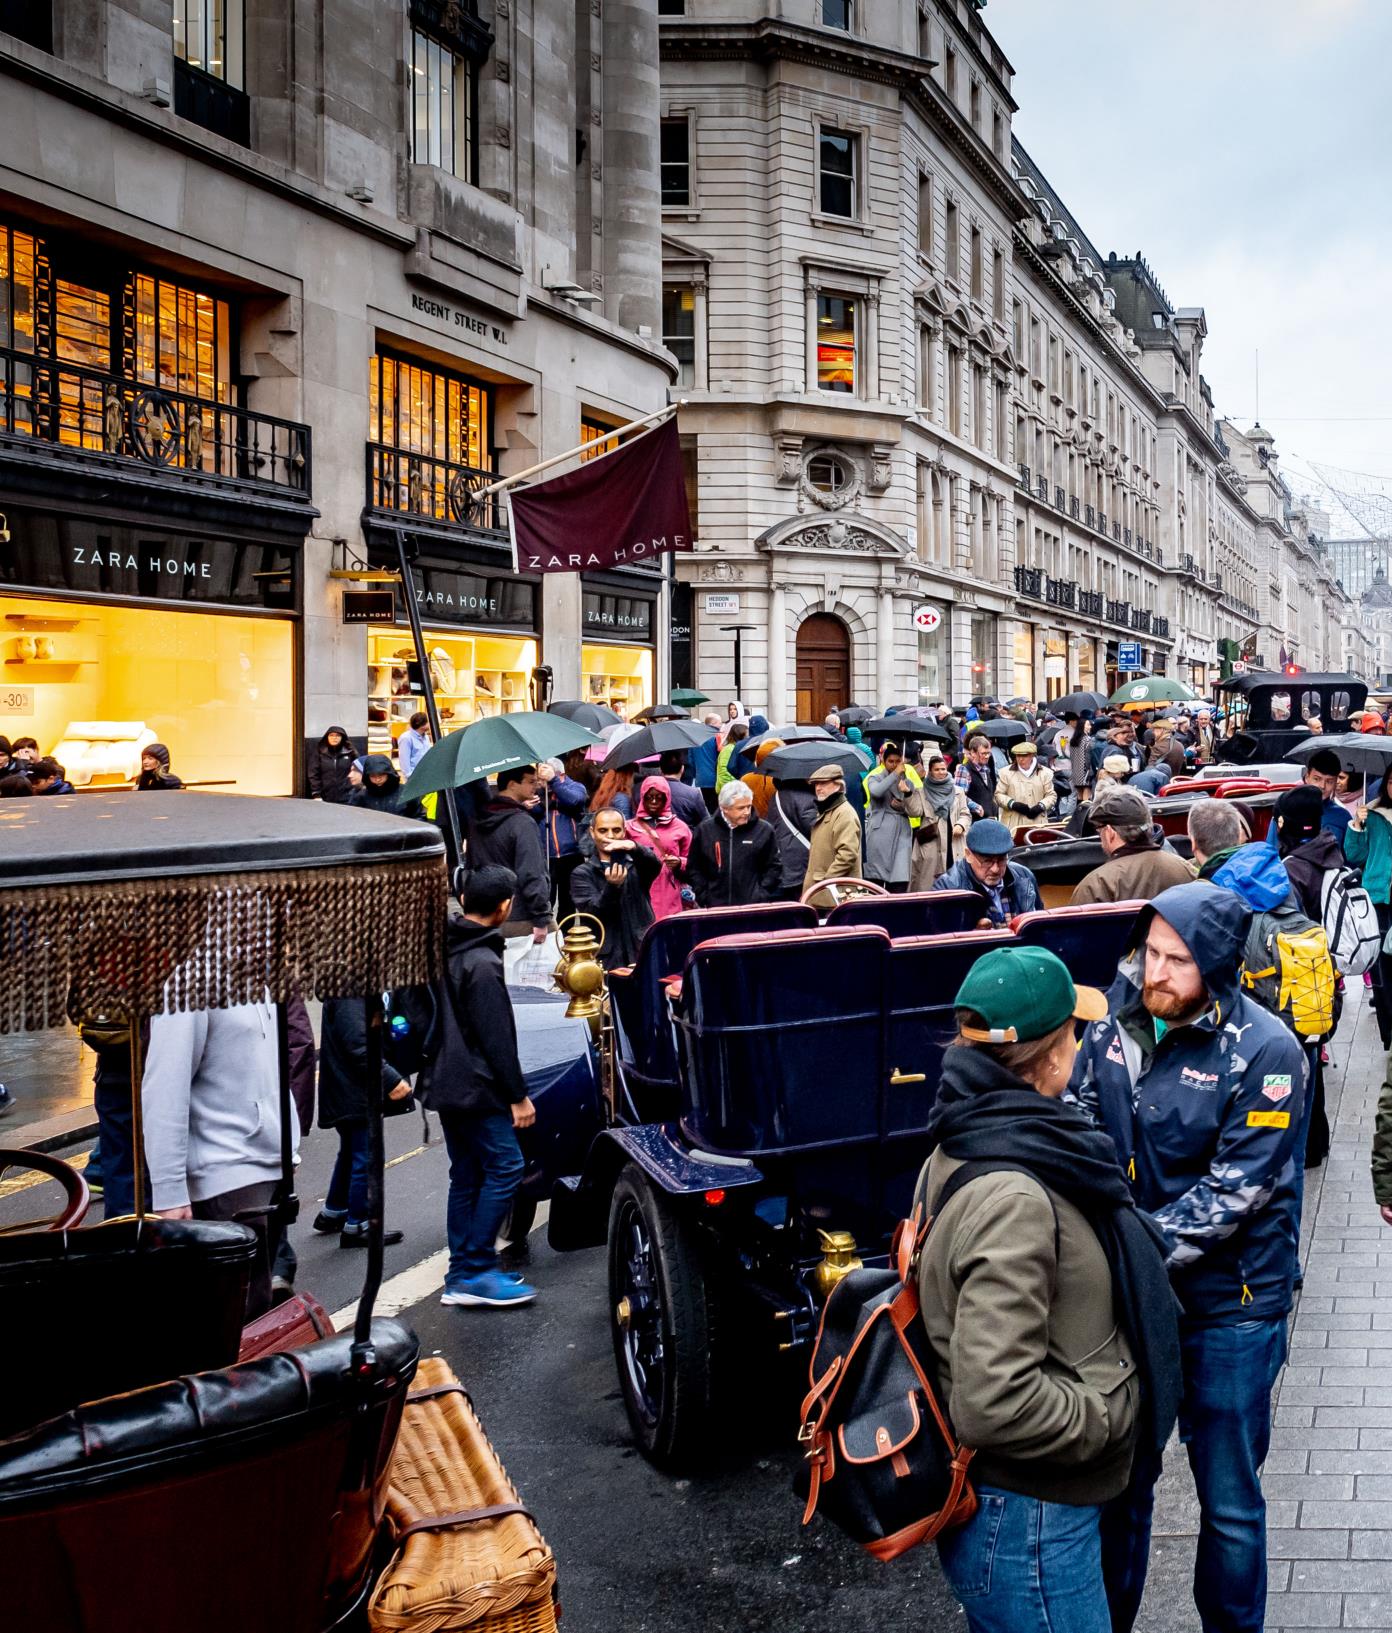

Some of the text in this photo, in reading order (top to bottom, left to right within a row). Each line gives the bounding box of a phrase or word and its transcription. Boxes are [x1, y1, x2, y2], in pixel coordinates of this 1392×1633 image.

[411, 293, 450, 321] REGENT
[454, 311, 488, 337] STREET
[73, 547, 211, 578] ZARA HOME
[528, 535, 687, 568] ZARA HOME
[416, 590, 497, 611] ZARA HOME
[588, 611, 644, 627] ZARA HOME
[671, 626, 690, 634] DON
